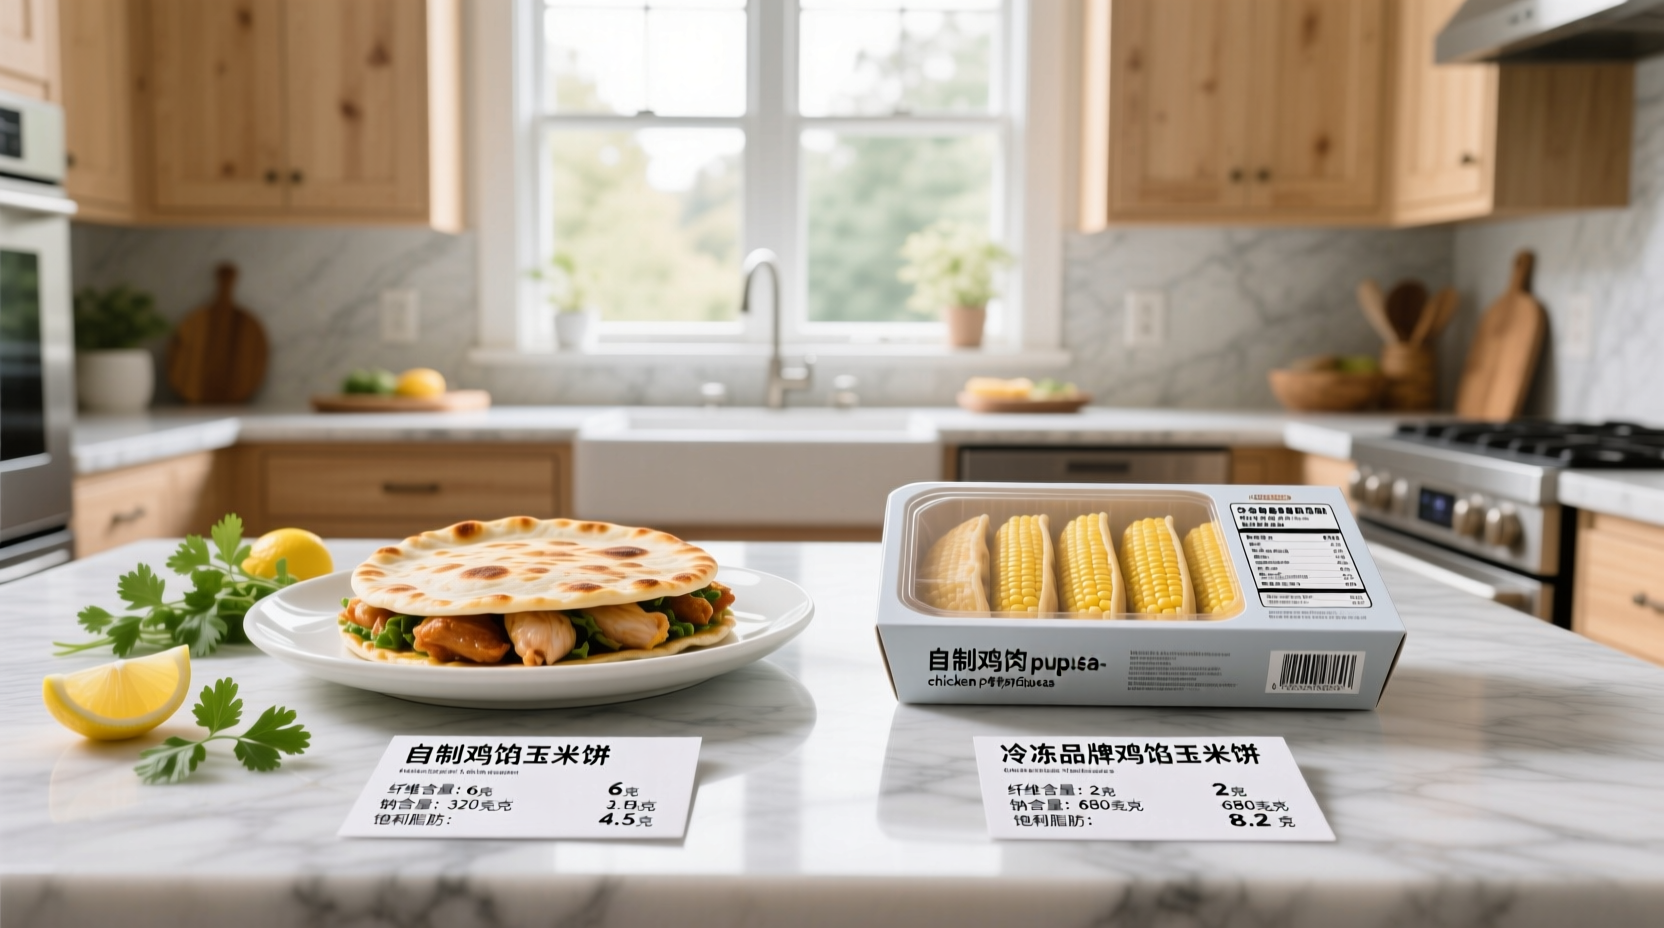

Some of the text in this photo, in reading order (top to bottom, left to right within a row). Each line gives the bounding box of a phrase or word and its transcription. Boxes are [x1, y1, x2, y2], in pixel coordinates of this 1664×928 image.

[928, 674, 976, 687] chicken
[1000, 743, 1261, 765] 冷冻品牌鸡馅玉米饼
